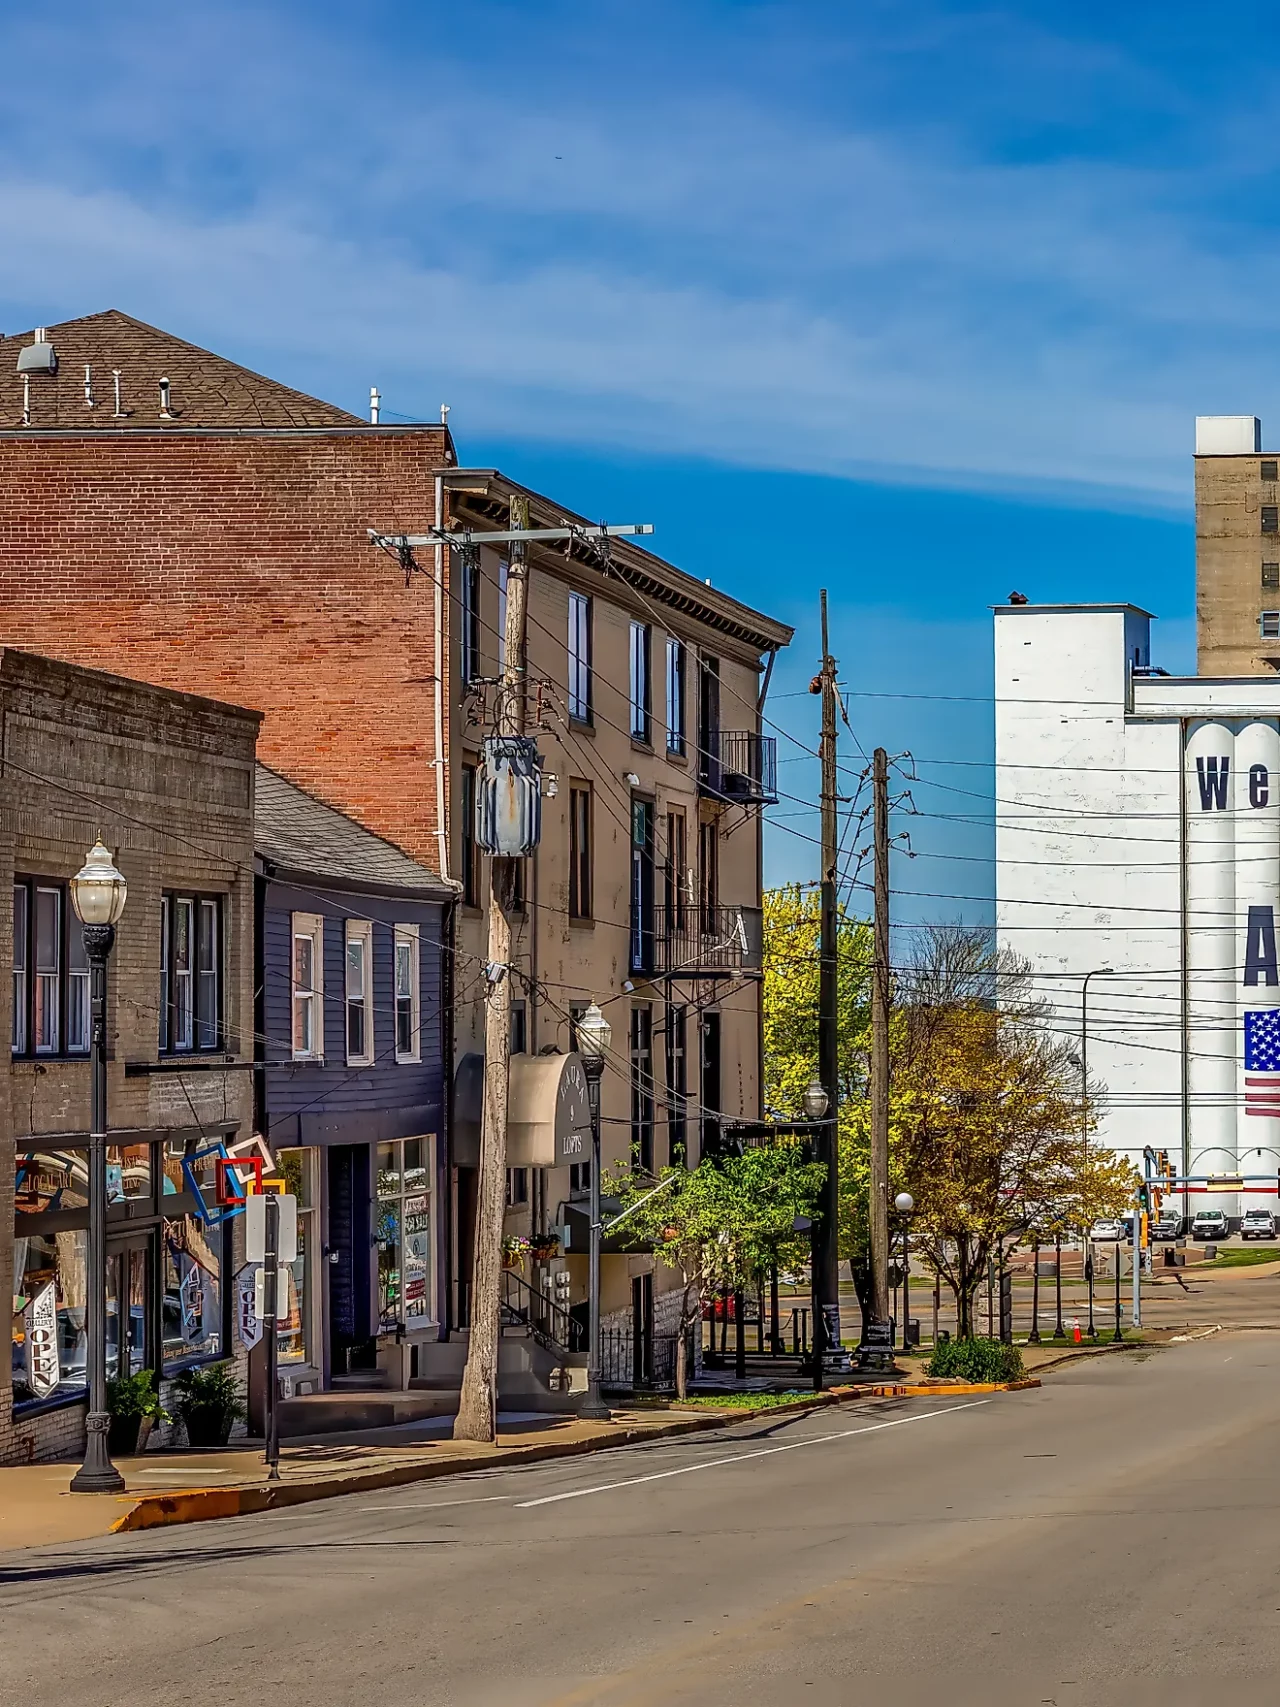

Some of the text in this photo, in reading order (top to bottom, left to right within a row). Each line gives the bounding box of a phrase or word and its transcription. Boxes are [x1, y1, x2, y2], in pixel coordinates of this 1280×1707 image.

[563, 1135, 582, 1155] LOFTS
[28, 1170, 73, 1193] LOCAL ART
[30, 1329, 51, 1388] OPEN
